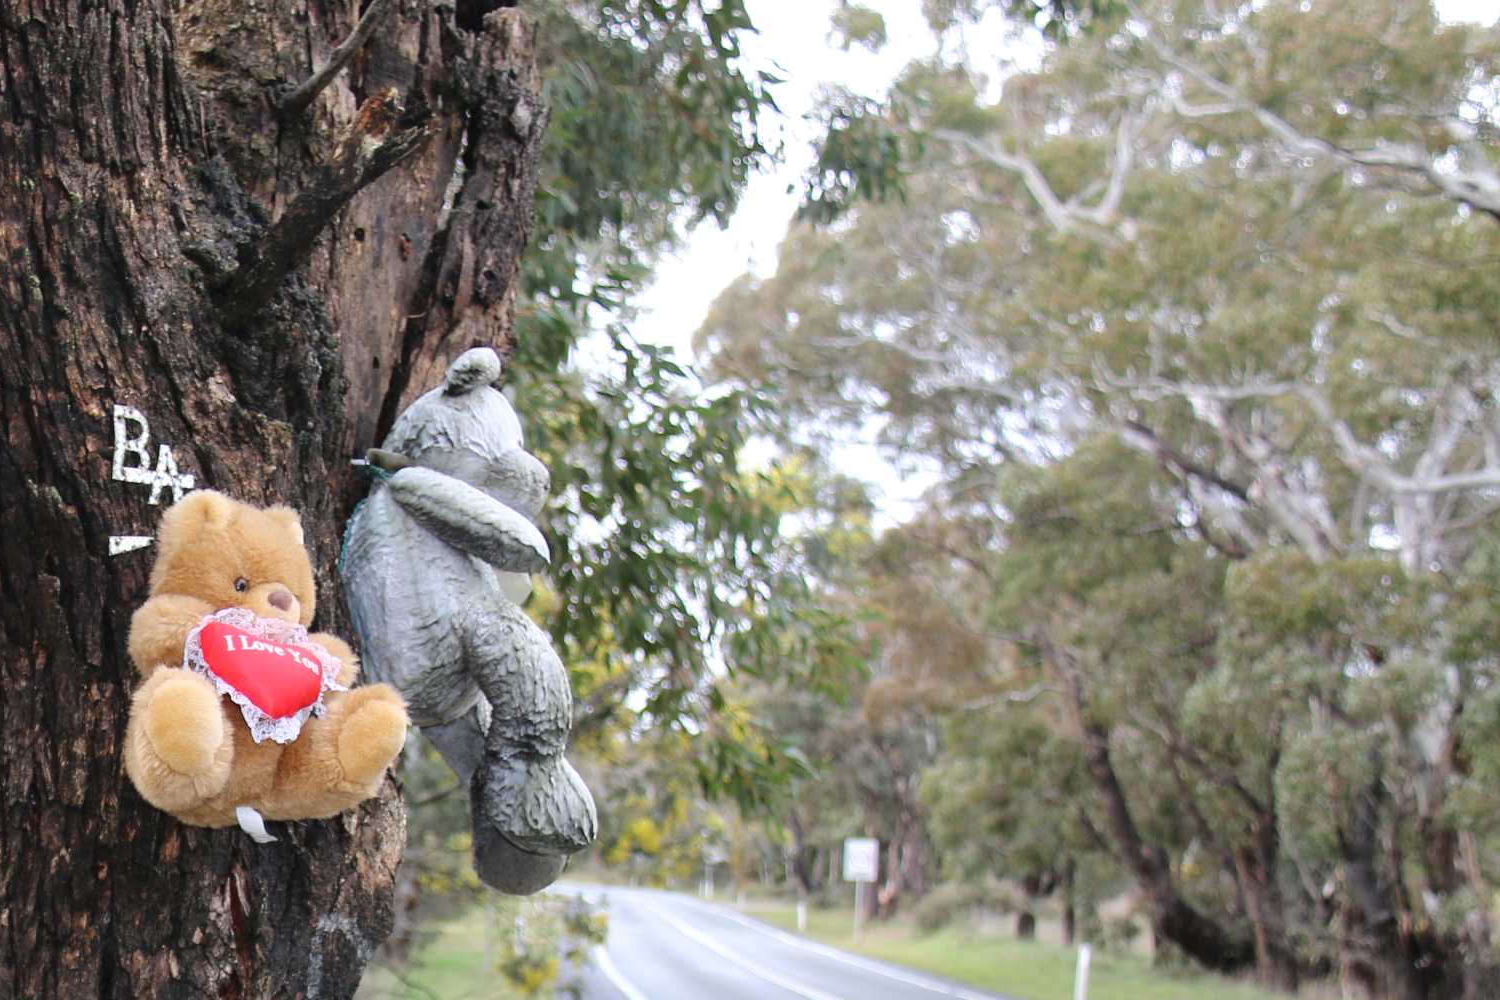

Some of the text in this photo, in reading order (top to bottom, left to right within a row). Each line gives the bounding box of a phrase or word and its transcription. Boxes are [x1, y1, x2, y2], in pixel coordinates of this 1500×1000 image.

[223, 634, 320, 676] I Love You
